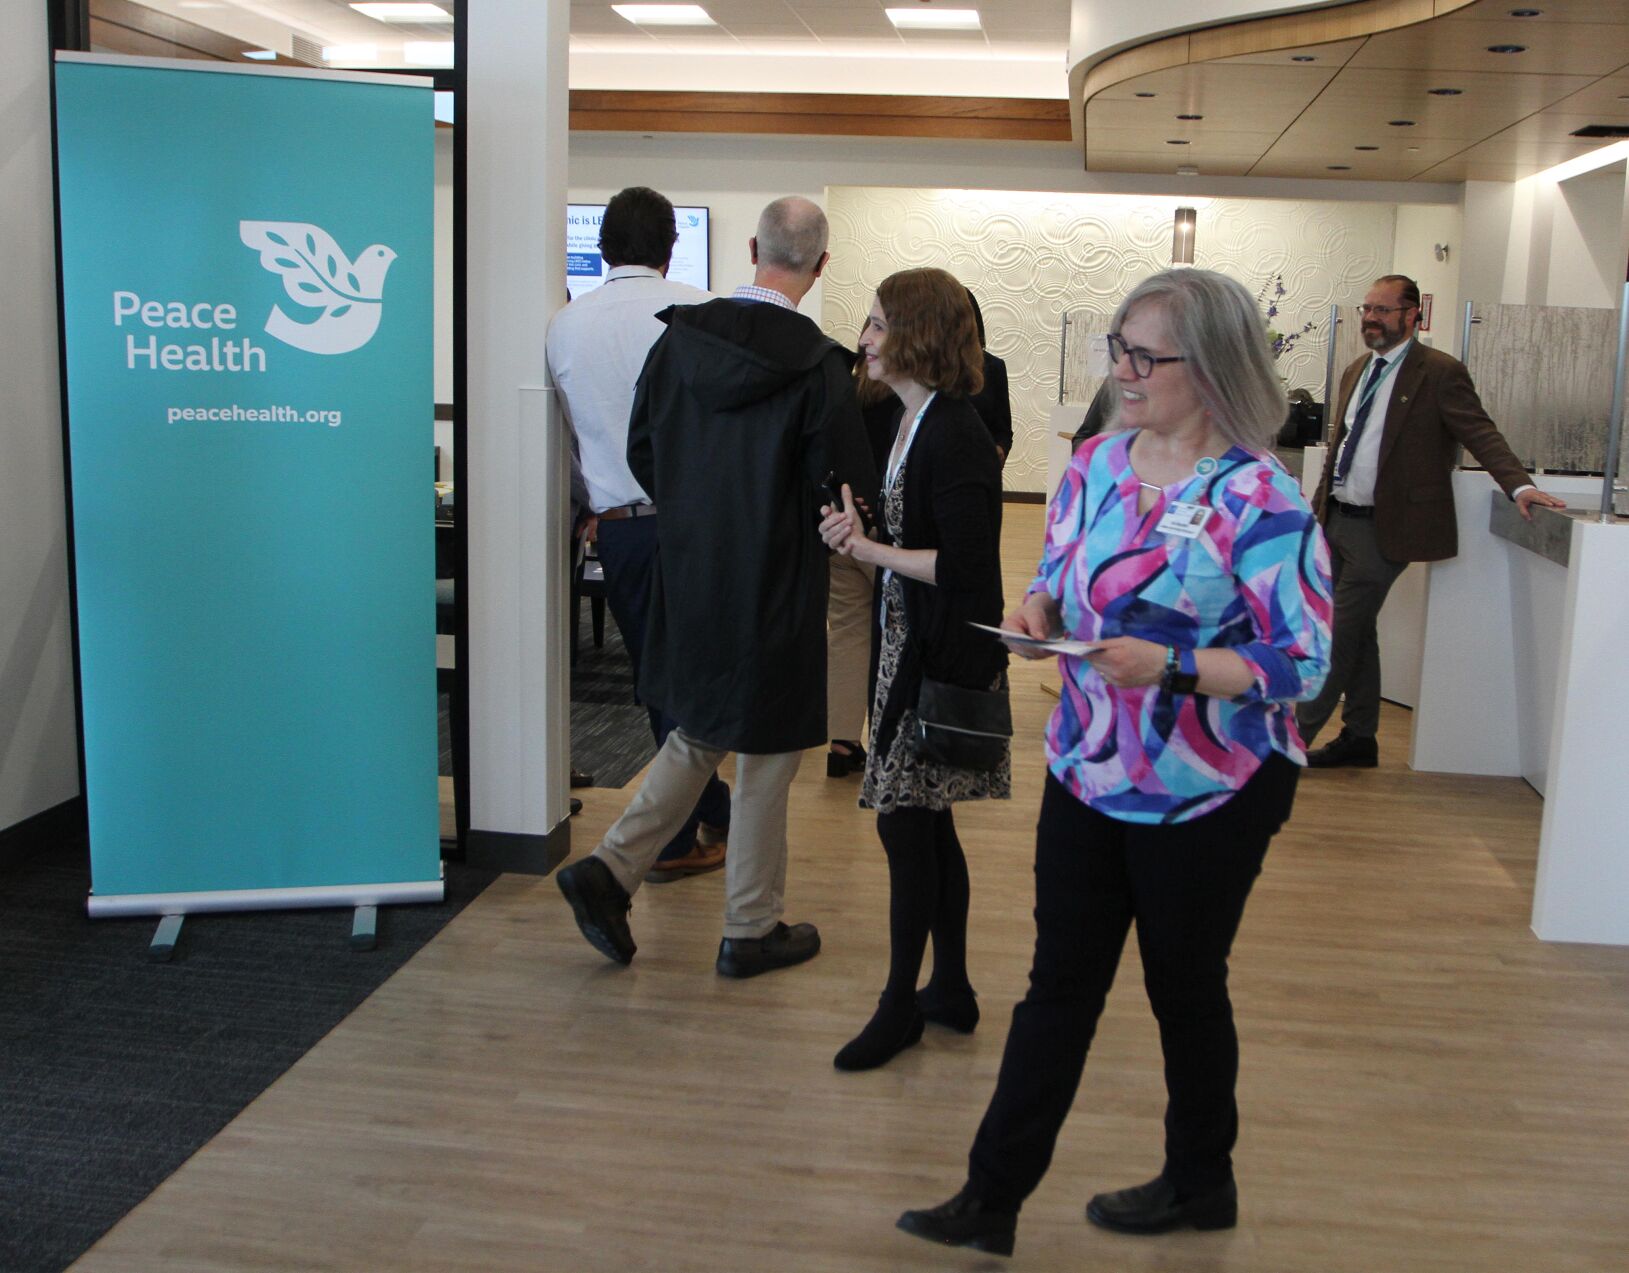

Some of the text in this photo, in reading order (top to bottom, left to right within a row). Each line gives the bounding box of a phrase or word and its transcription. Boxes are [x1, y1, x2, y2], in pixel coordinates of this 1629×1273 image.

[582, 215, 590, 225] is
[113, 291, 237, 330] Peace
[126, 334, 267, 372] Health
[167, 405, 342, 427] peacehealth.org
